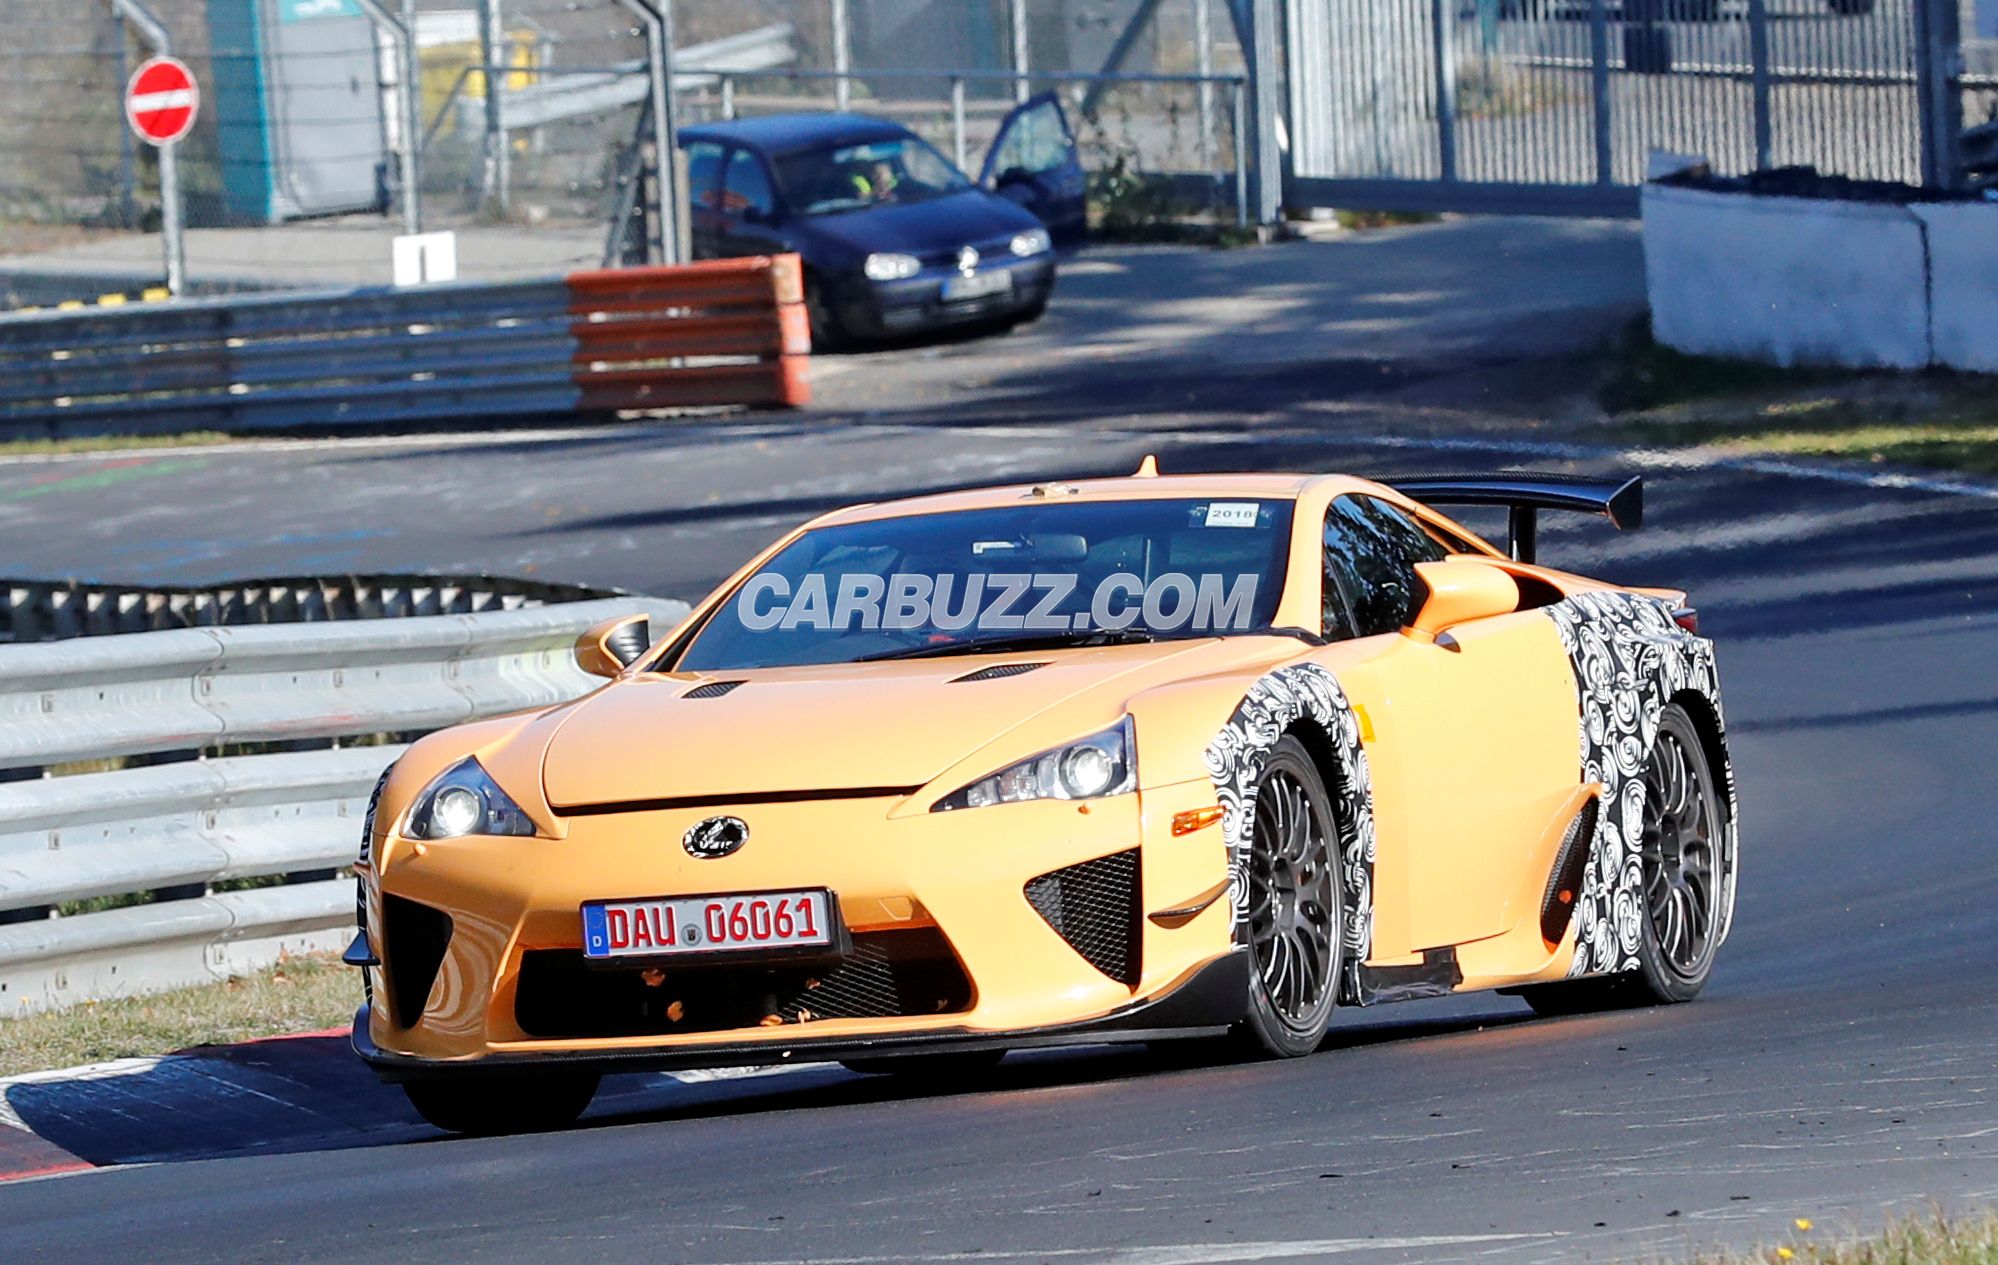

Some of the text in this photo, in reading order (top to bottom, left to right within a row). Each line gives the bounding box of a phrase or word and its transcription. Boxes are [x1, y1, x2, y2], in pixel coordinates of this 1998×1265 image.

[1211, 510, 1253, 519] 2018
[592, 898, 818, 949] D DAU 06061
